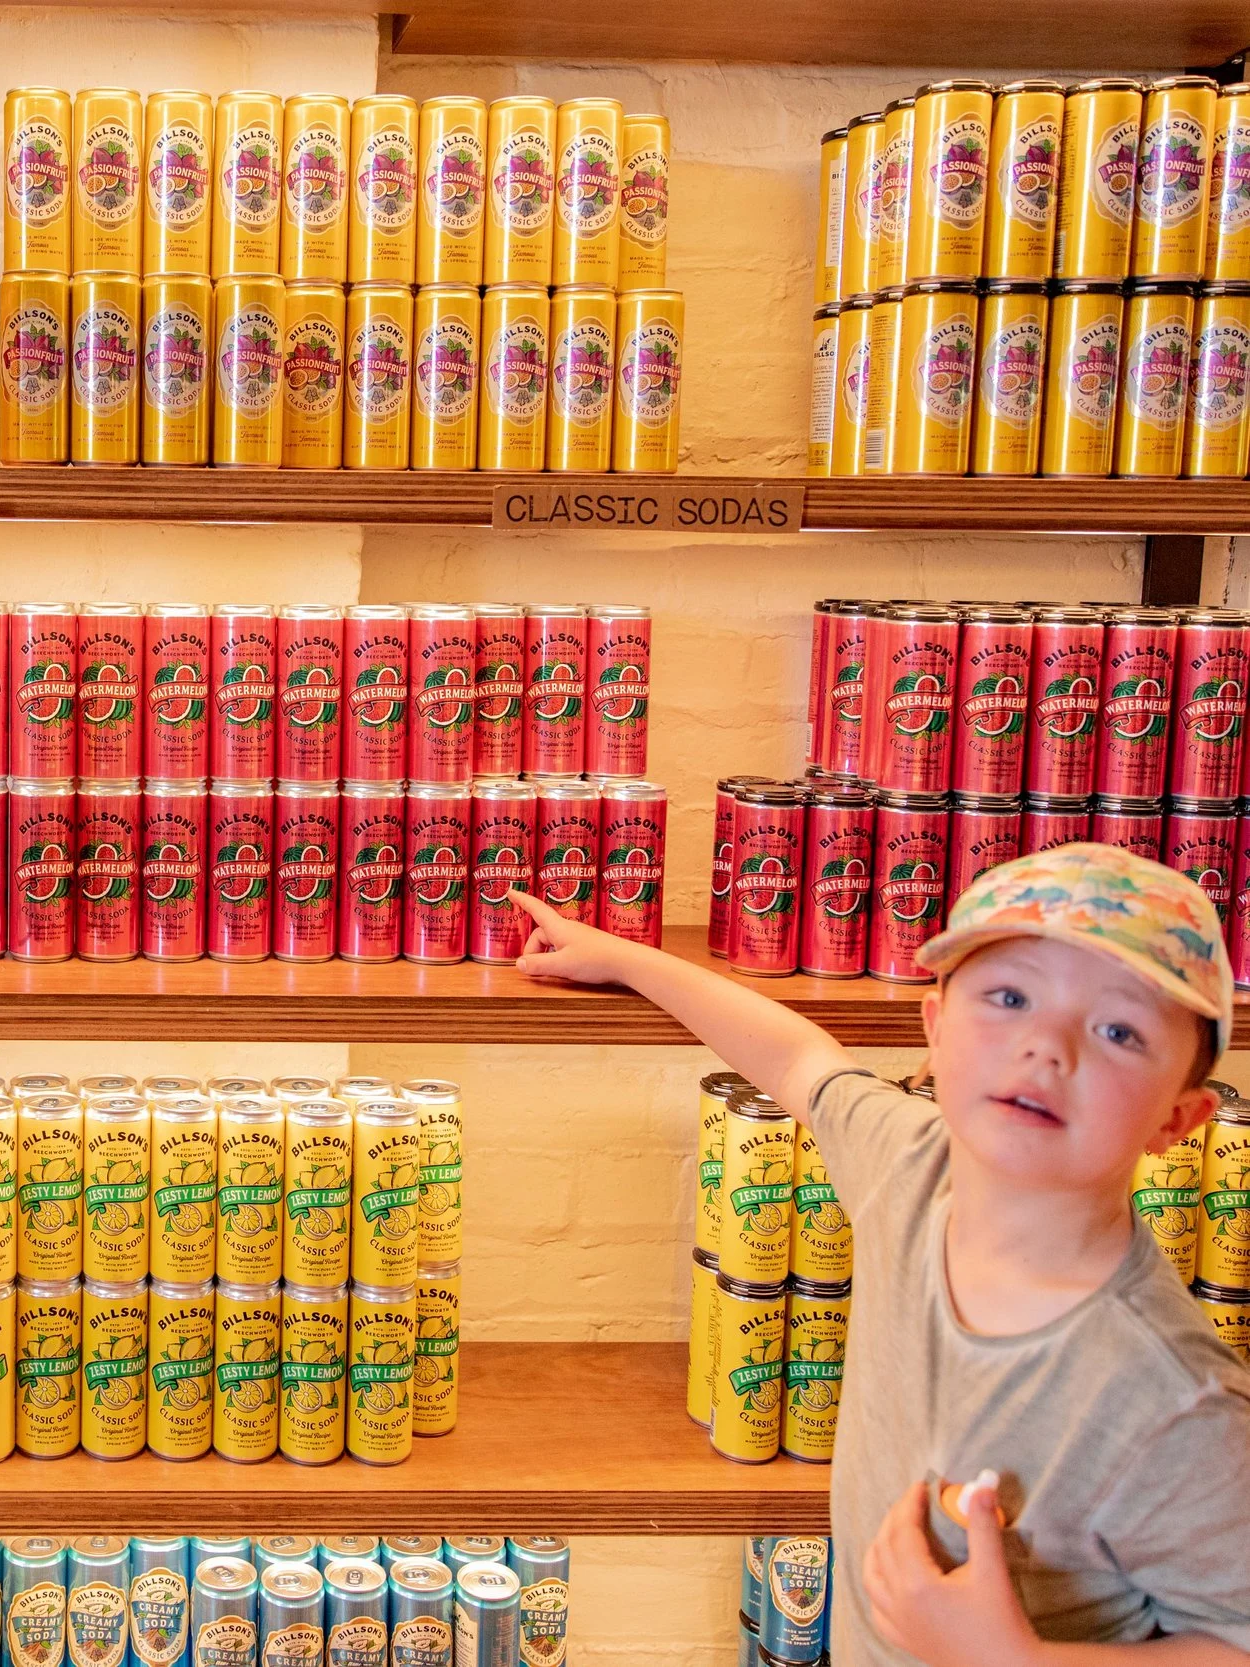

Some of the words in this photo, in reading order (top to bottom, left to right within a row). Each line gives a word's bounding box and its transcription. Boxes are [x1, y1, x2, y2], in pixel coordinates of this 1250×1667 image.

[14, 126, 63, 146] BILLSON'S
[565, 137, 614, 158] BILLSON'S
[84, 166, 137, 181] PASSIONFRUIT
[563, 172, 617, 188] PASSIONFRUIT
[85, 201, 115, 219] CLASSIC
[117, 202, 134, 218] SODA
[1014, 198, 1045, 220] CLASSIC
[9, 310, 58, 330] BILLSON'S
[289, 322, 336, 343] BILLSON'S
[7, 349, 63, 365] PASSIONFRUIT
[287, 360, 340, 374] PASSIONFRUIT
[8, 385, 38, 403] CLASSIC
[42, 385, 58, 402] SODA
[287, 393, 317, 411] CLASSIC
[318, 394, 335, 410] SODA
[506, 495, 658, 524] CLASSIC
[678, 498, 788, 526] SODAS
[80, 631, 136, 657] BILLSON'S
[284, 635, 341, 660] BILLSON'S
[79, 684, 136, 700] WATERMELON
[283, 685, 341, 703] WATERMELON
[285, 729, 321, 746] CLASSIC
[322, 731, 338, 746] SODA
[738, 826, 798, 848] BILLSON'S
[473, 866, 532, 880] WATERMELON
[602, 866, 662, 881] WATERMELON
[736, 877, 797, 889] WATERMELON
[737, 916, 769, 935] CLASSIC
[88, 1131, 149, 1153] BILLSON'S
[222, 1133, 282, 1155] BILLSON'S
[88, 1189, 116, 1202] ZESTY
[118, 1186, 147, 1199] LEMON
[222, 1189, 249, 1203] ZESTY
[251, 1188, 281, 1201] LEMON
[738, 1189, 770, 1203] ZESTY
[222, 1233, 257, 1254] CLASSIC
[260, 1234, 279, 1252] SODA
[739, 1232, 776, 1251] CLASSIC
[231, 1254, 253, 1263] Original
[20, 1306, 80, 1327] BILLSON'S
[284, 1311, 344, 1333] BILLSON'S
[20, 1362, 47, 1375] ZESTY
[49, 1358, 79, 1373] LEMON
[284, 1366, 308, 1379] ZESTY
[311, 1365, 342, 1378] LEMON
[284, 1407, 316, 1431] CLASSIC
[319, 1411, 340, 1429] SODA
[783, 1543, 825, 1555] BILLSON'S
[784, 1564, 823, 1576] CREAMY
[137, 1578, 182, 1592] BILLSON'S
[790, 1580, 818, 1588] SODA
[139, 1603, 180, 1615] CREAMY
[527, 1611, 566, 1623] CREAMY
[77, 1614, 118, 1627] CREAMY
[144, 1618, 174, 1629] SODA
[82, 1629, 112, 1639] SODA
[338, 1626, 383, 1640] BILLSON'S
[533, 1626, 561, 1636] SODA
